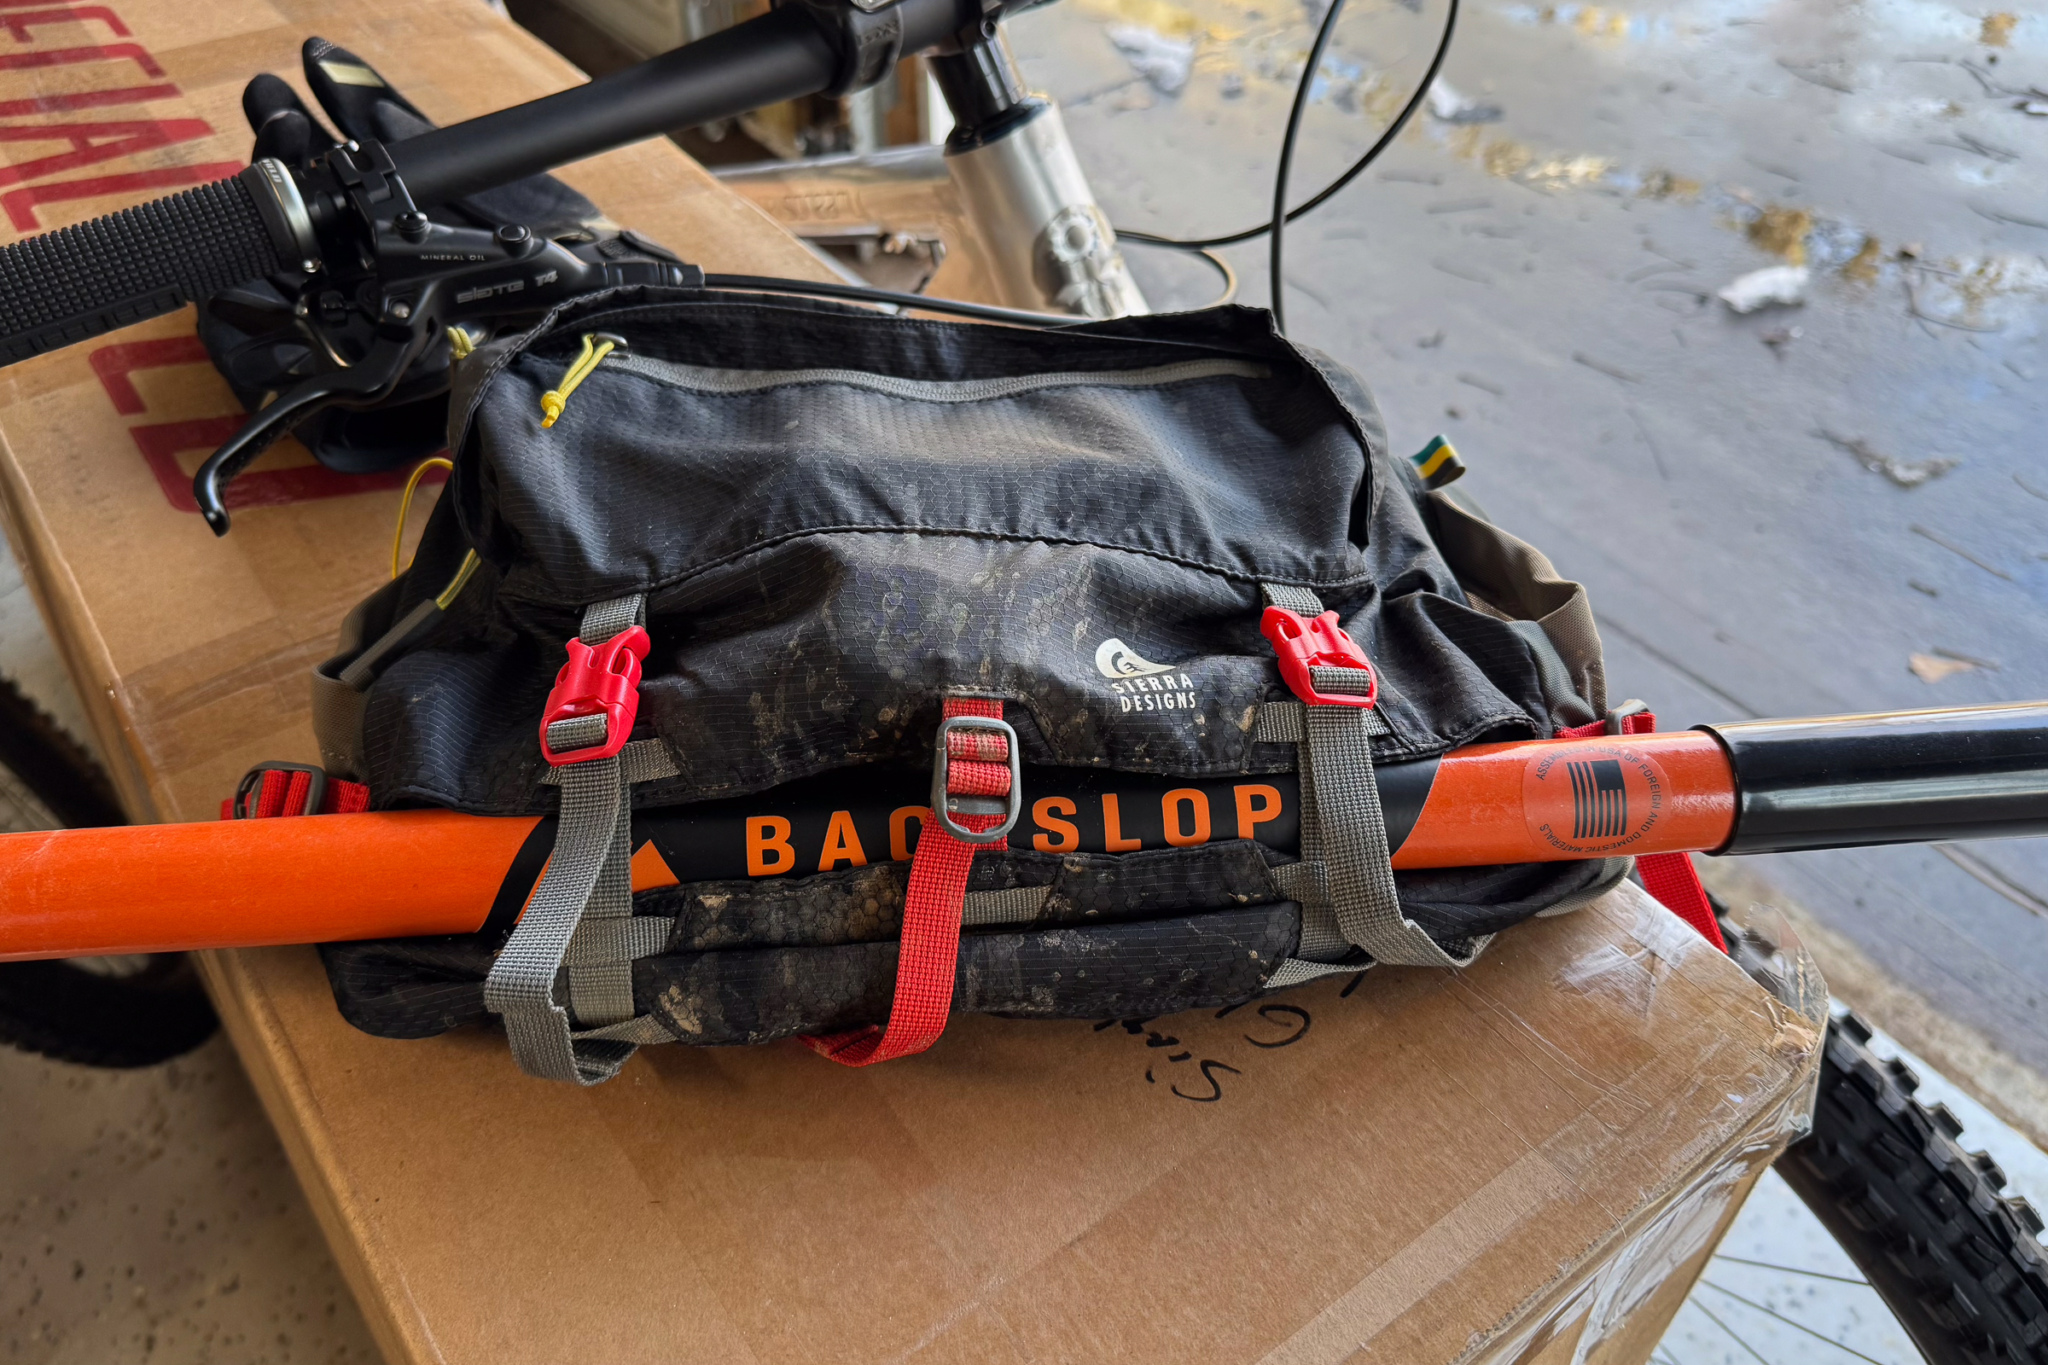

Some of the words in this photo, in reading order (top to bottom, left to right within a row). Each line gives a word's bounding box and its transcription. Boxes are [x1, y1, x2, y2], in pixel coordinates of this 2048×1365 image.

[420, 254, 465, 262] MINERAL
[469, 254, 486, 262] OIL
[535, 270, 558, 288] T4
[1111, 673, 1194, 694] SIERRA
[1119, 691, 1196, 713] DESIGNS
[1598, 746, 1622, 757] USA
[1624, 753, 1640, 764] OF
[1536, 747, 1581, 781] ASSEMBLED
[1638, 763, 1662, 809] FOREIGN
[745, 784, 1284, 876] BACSLOP
[1640, 812, 1659, 833] AND
[1539, 823, 1583, 853] MATERIALS
[1585, 832, 1642, 853] DOMESTIC
